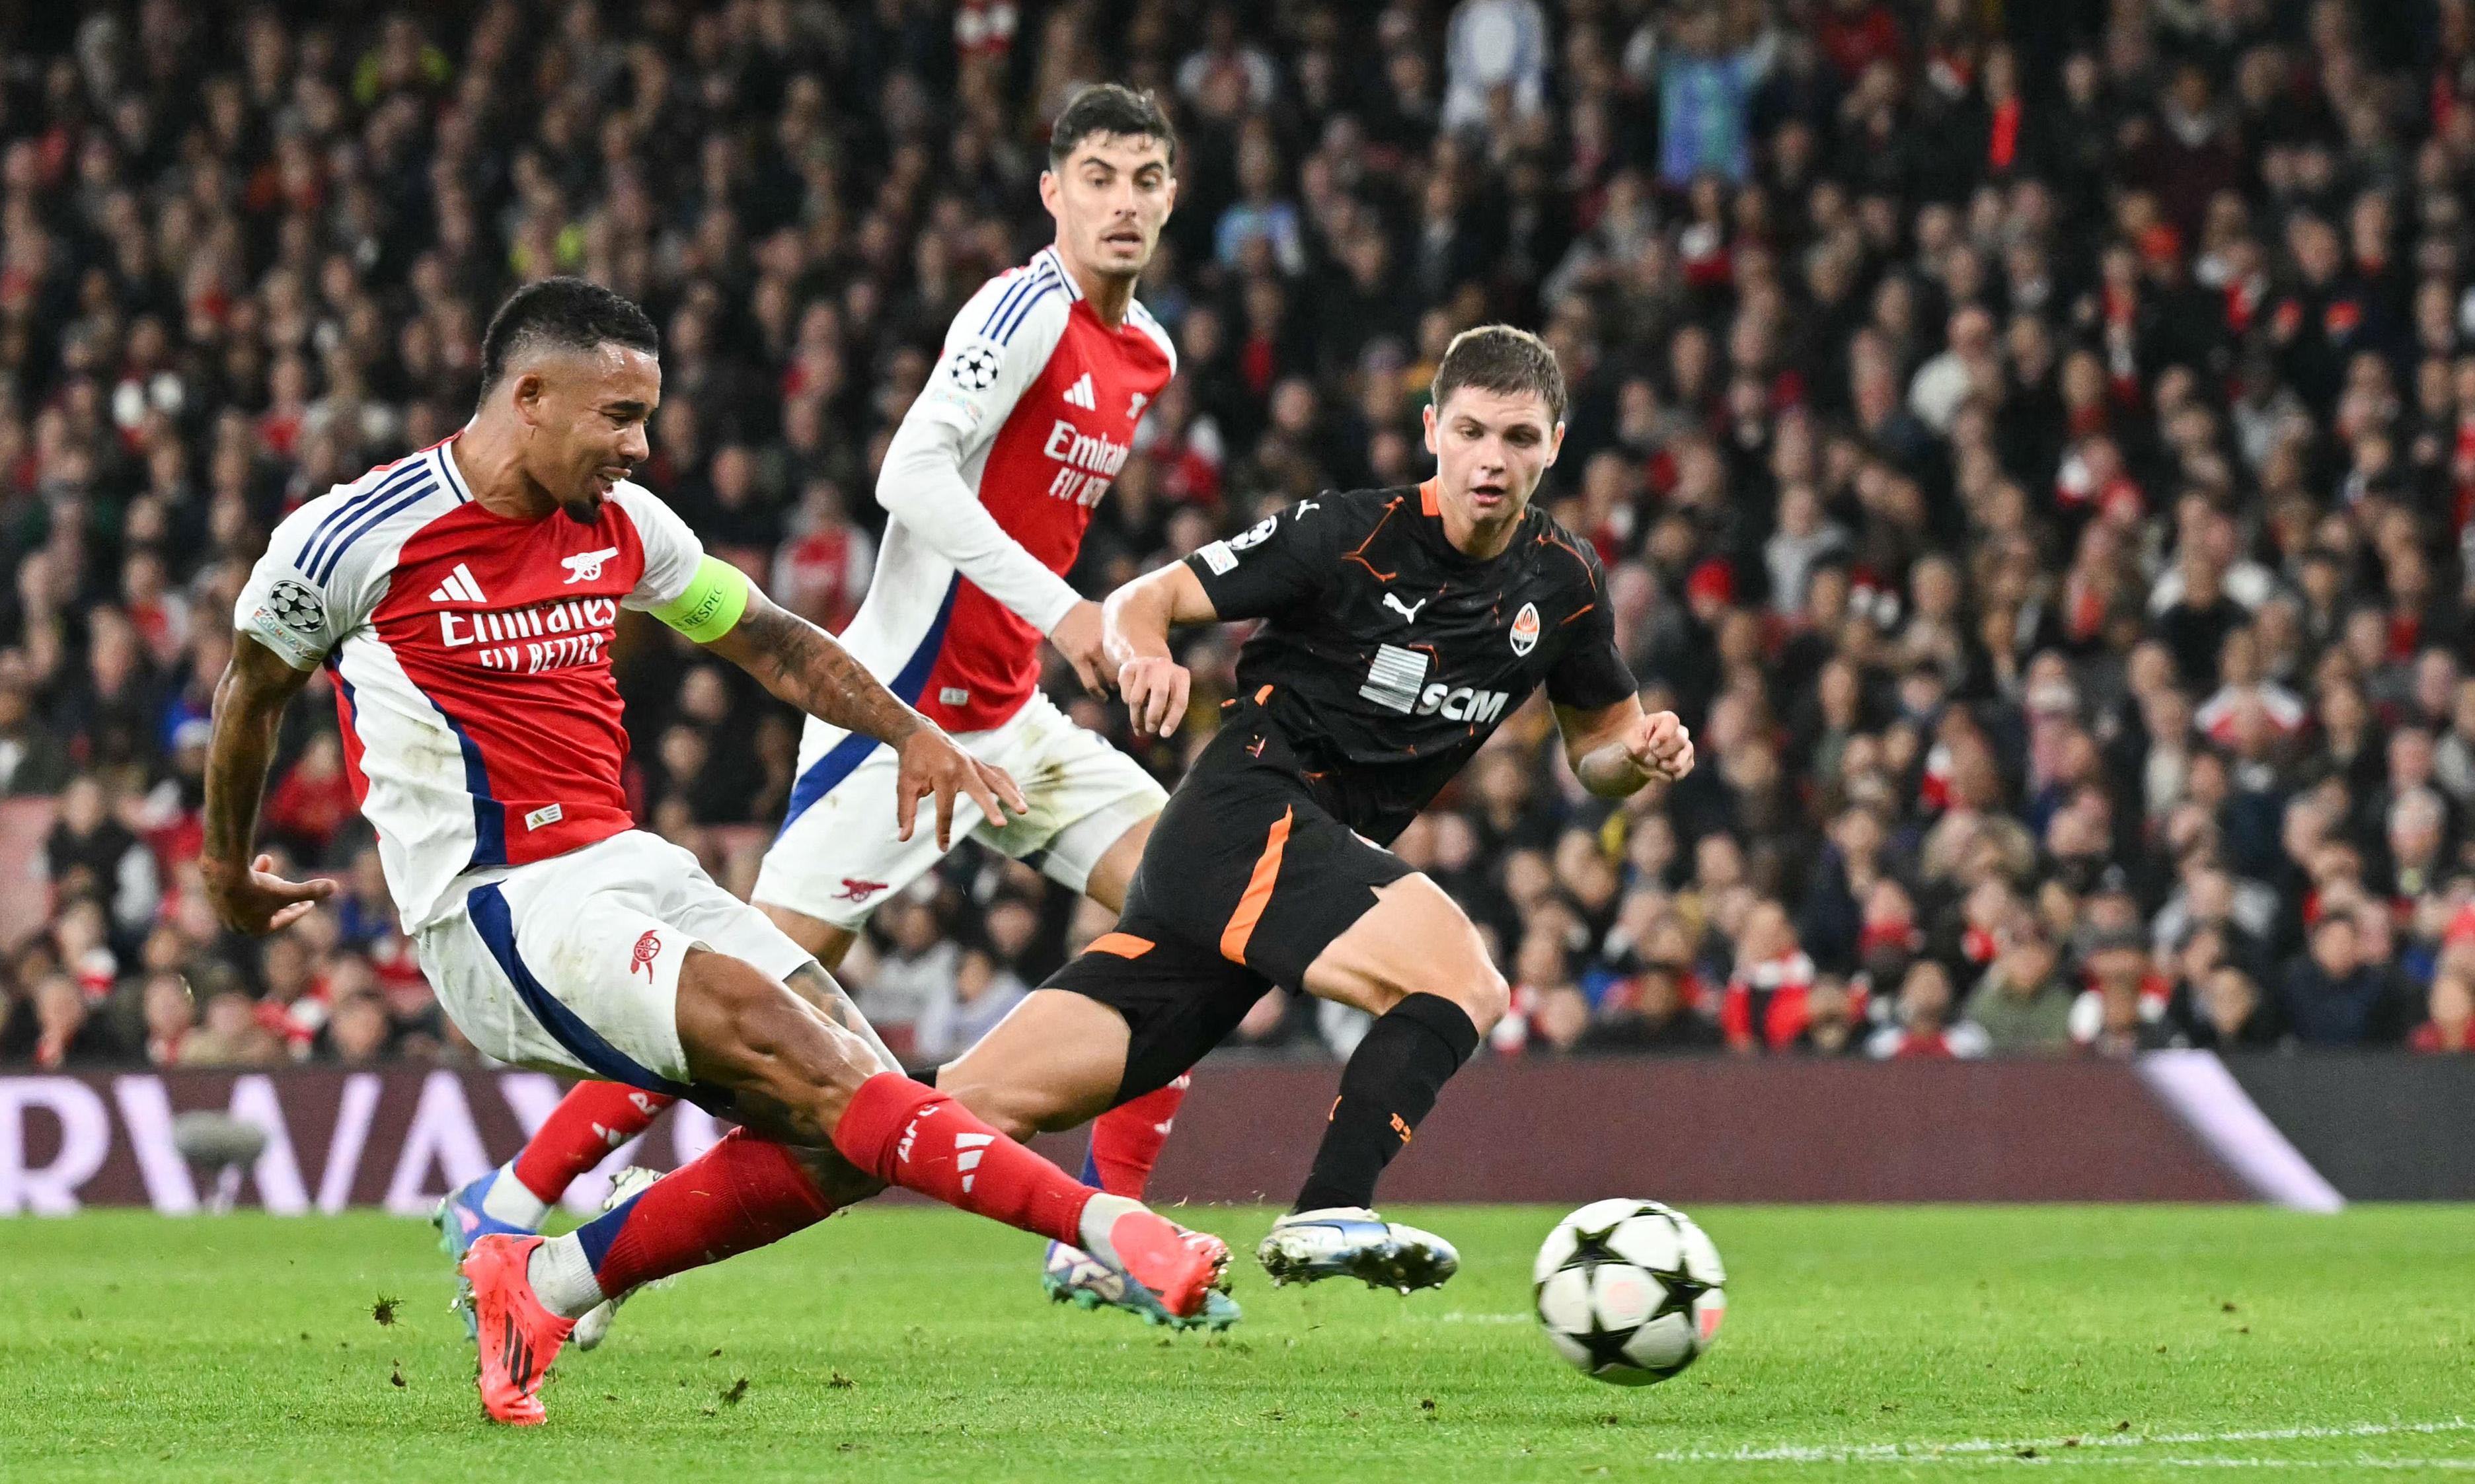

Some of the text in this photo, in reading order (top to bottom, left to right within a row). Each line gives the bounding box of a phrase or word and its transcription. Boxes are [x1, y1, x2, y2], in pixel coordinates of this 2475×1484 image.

[684, 577, 724, 626] RESPEC
[526, 632, 604, 675] BETTER
[1416, 683, 1509, 724] SCM
